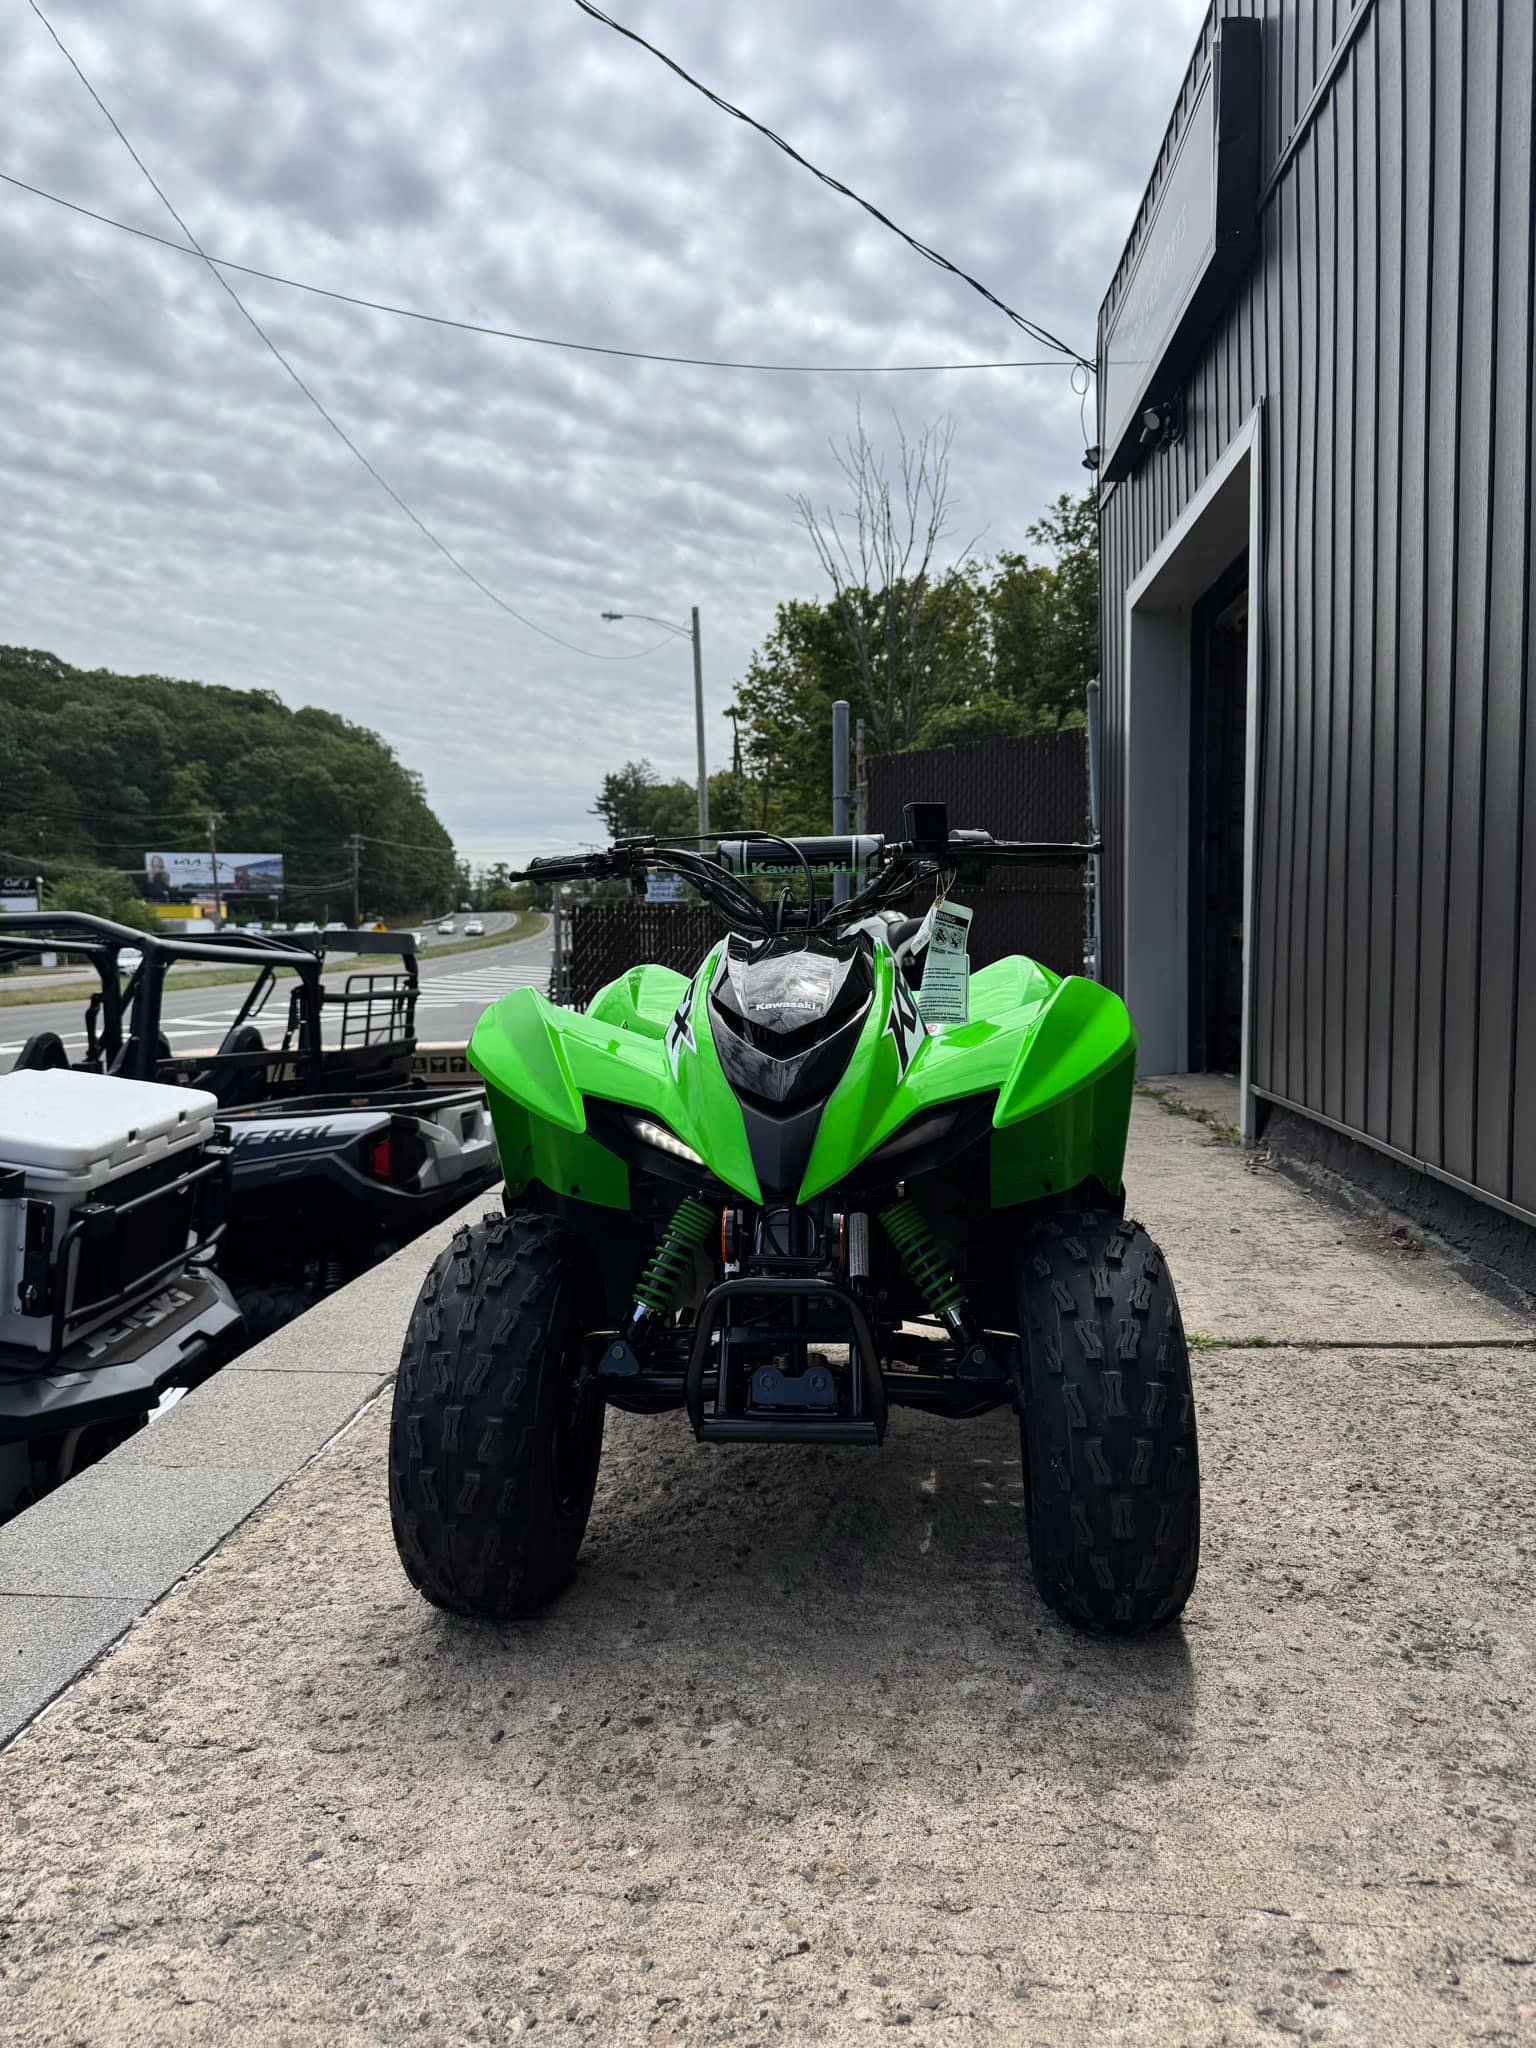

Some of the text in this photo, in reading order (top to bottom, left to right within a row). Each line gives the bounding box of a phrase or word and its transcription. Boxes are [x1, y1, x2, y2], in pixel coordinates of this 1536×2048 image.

[751, 861, 847, 874] Kawasaki
[756, 1001, 816, 1010] Kawasaki
[132, 1287, 194, 1328] SKI
